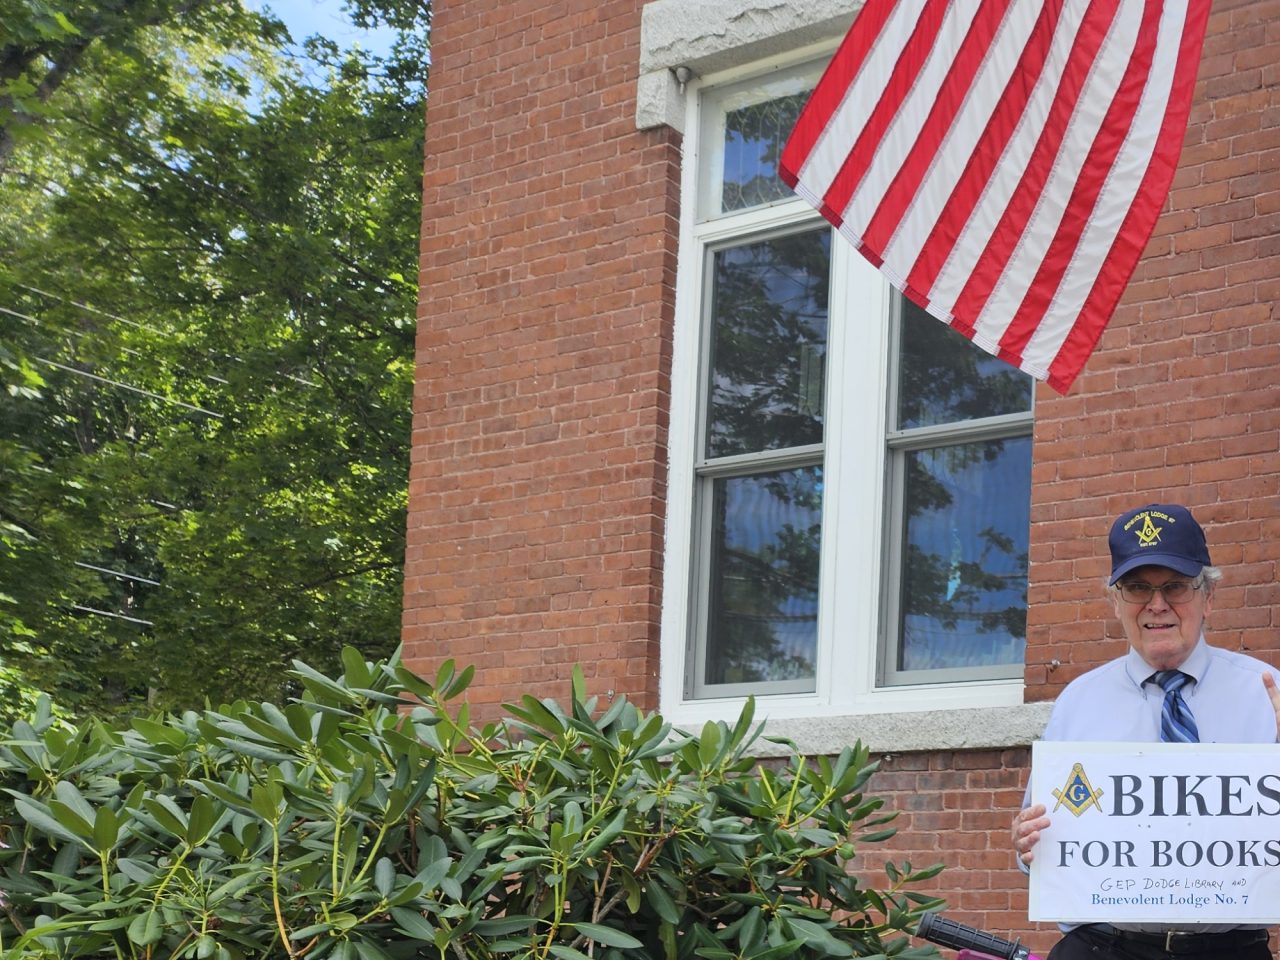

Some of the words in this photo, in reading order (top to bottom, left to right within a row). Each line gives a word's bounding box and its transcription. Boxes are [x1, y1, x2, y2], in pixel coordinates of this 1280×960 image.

[1056, 840, 1138, 868] FOR
[1143, 877, 1181, 889] DODGE
[1184, 877, 1224, 890] LIBRARY
[1091, 893, 1164, 905] Benevolent
[1169, 893, 1210, 908] Lodge
[1215, 894, 1237, 905] No.
[1241, 895, 1249, 905] 7
